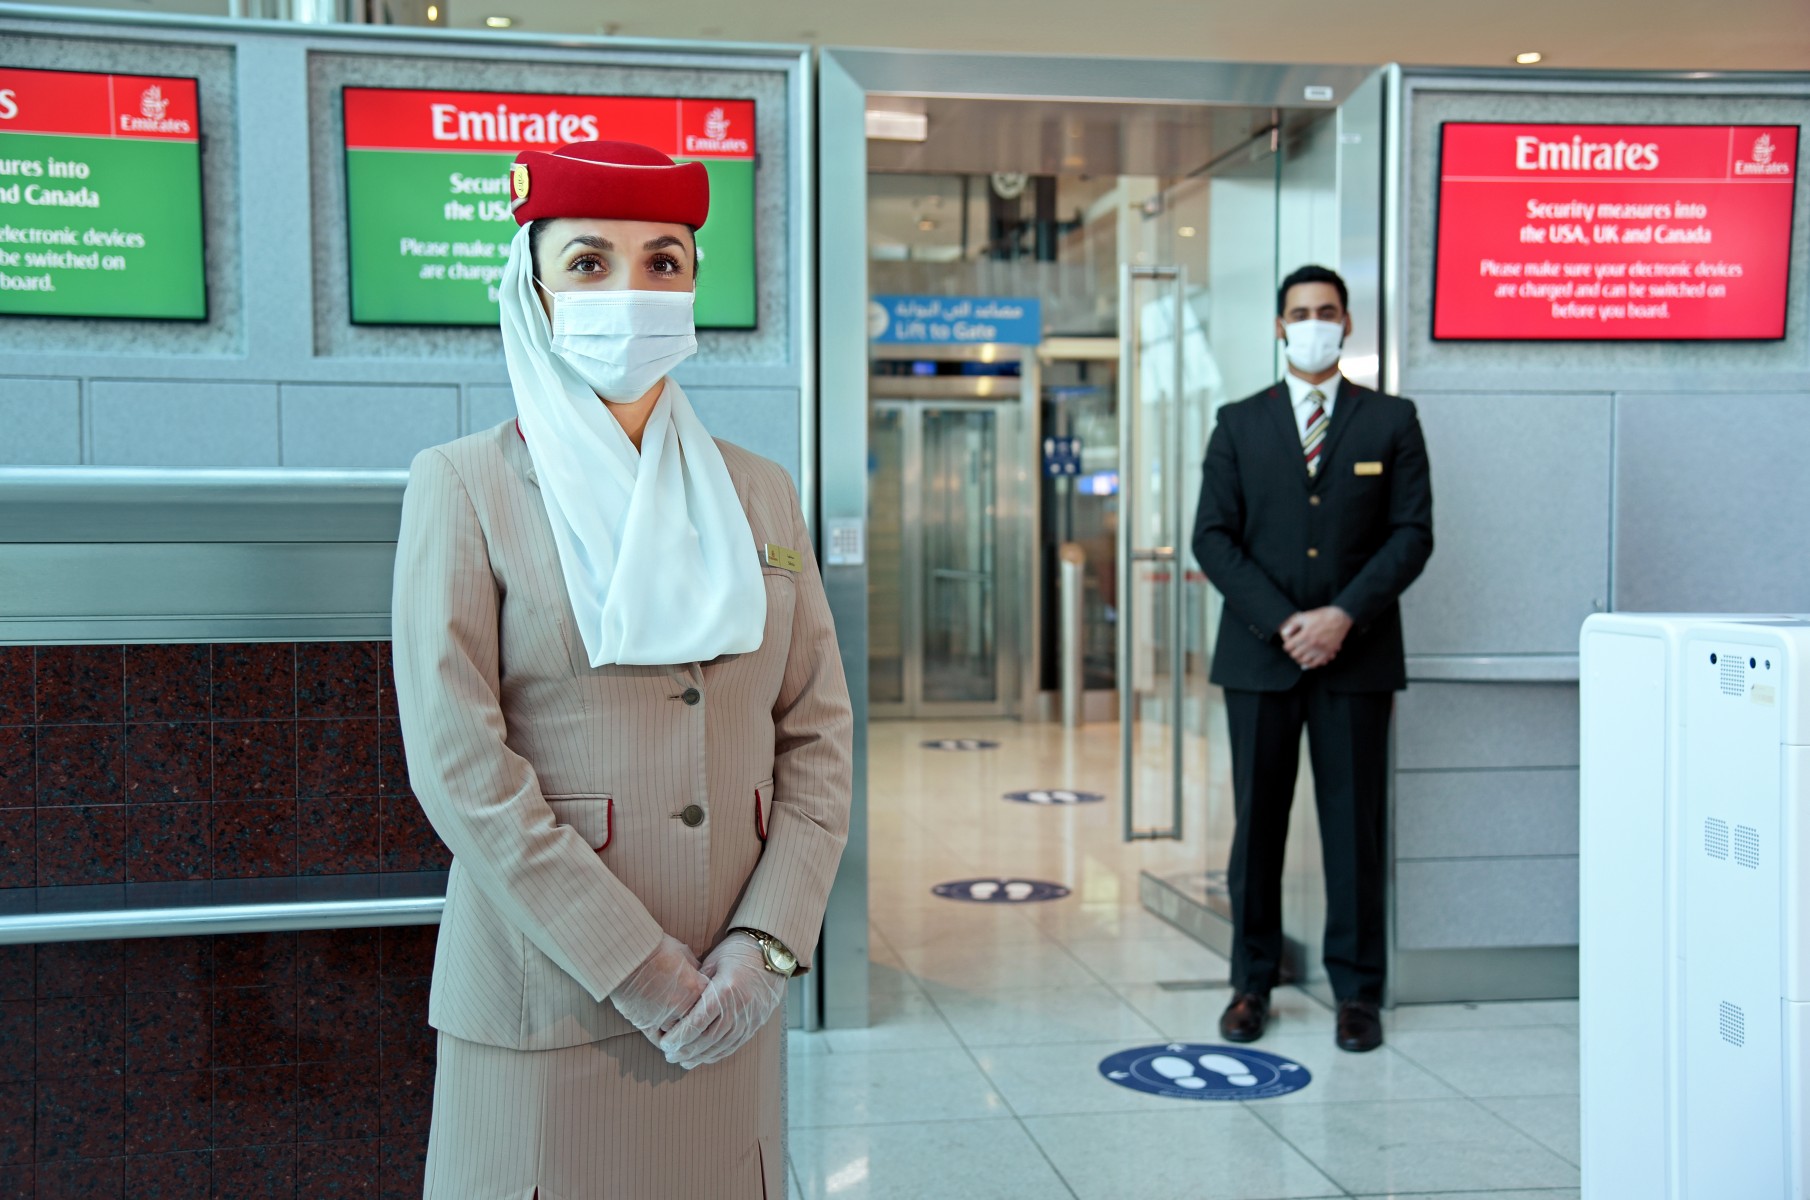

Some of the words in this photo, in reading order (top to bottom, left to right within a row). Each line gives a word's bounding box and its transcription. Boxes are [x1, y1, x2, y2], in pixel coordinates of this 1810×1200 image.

[120, 113, 190, 134] Emirates
[430, 103, 599, 144] Emirates
[686, 135, 748, 152] Emirates
[1515, 135, 1659, 171] Emirates
[48, 156, 90, 179] into
[1734, 160, 1789, 175] Emirates
[24, 183, 100, 208] Canada
[444, 199, 475, 220] the
[1526, 198, 1596, 223] Security
[1597, 202, 1672, 220] measures
[1674, 199, 1707, 220] into
[82, 227, 145, 248] devices
[1519, 224, 1547, 243] the
[1549, 223, 1591, 246] USA,
[1593, 224, 1619, 244] UK
[1620, 224, 1652, 244] and
[1653, 224, 1712, 244] Canada
[400, 237, 449, 257] Please
[452, 240, 496, 258] make
[24, 249, 99, 270] switched
[102, 254, 126, 271] on
[1480, 258, 1522, 277] Please
[1523, 259, 1562, 277] make
[1563, 262, 1593, 277] sure
[1594, 262, 1627, 281] your
[1628, 260, 1693, 278] electronic
[1694, 260, 1743, 278] devices
[0, 270, 56, 292] board.
[418, 264, 446, 280] are
[1494, 282, 1518, 298] are
[1518, 280, 1574, 302] charged
[1573, 280, 1601, 298] and
[1601, 283, 1627, 298] can
[1627, 281, 1647, 298] be
[1647, 280, 1706, 298] switched
[1706, 283, 1726, 298] on
[1551, 301, 1598, 319] before
[1598, 304, 1626, 322] you
[1626, 301, 1670, 319] board.
[894, 320, 926, 341] Lift
[929, 323, 951, 341] to
[952, 320, 997, 342] Gate
